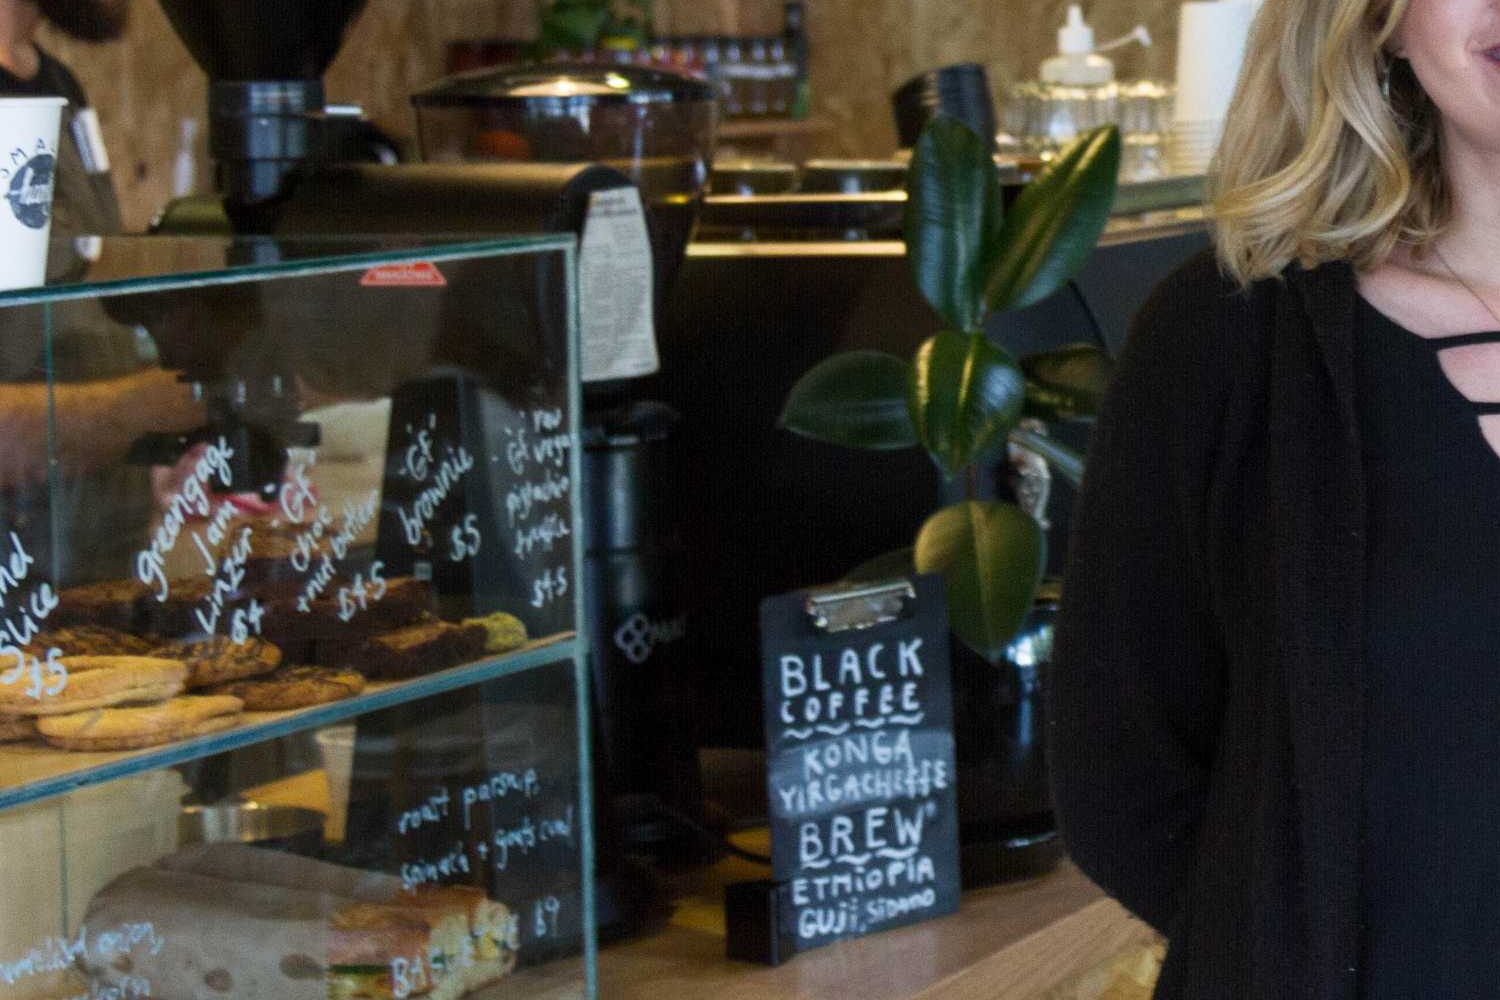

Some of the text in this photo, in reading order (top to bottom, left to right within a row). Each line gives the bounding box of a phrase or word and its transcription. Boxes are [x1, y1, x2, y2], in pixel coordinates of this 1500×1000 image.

[398, 447, 473, 545] brownie
[780, 637, 923, 697] BLACK
[781, 681, 919, 724] COFFEE
[804, 729, 915, 780] KONGA
[800, 803, 925, 862] BREW
